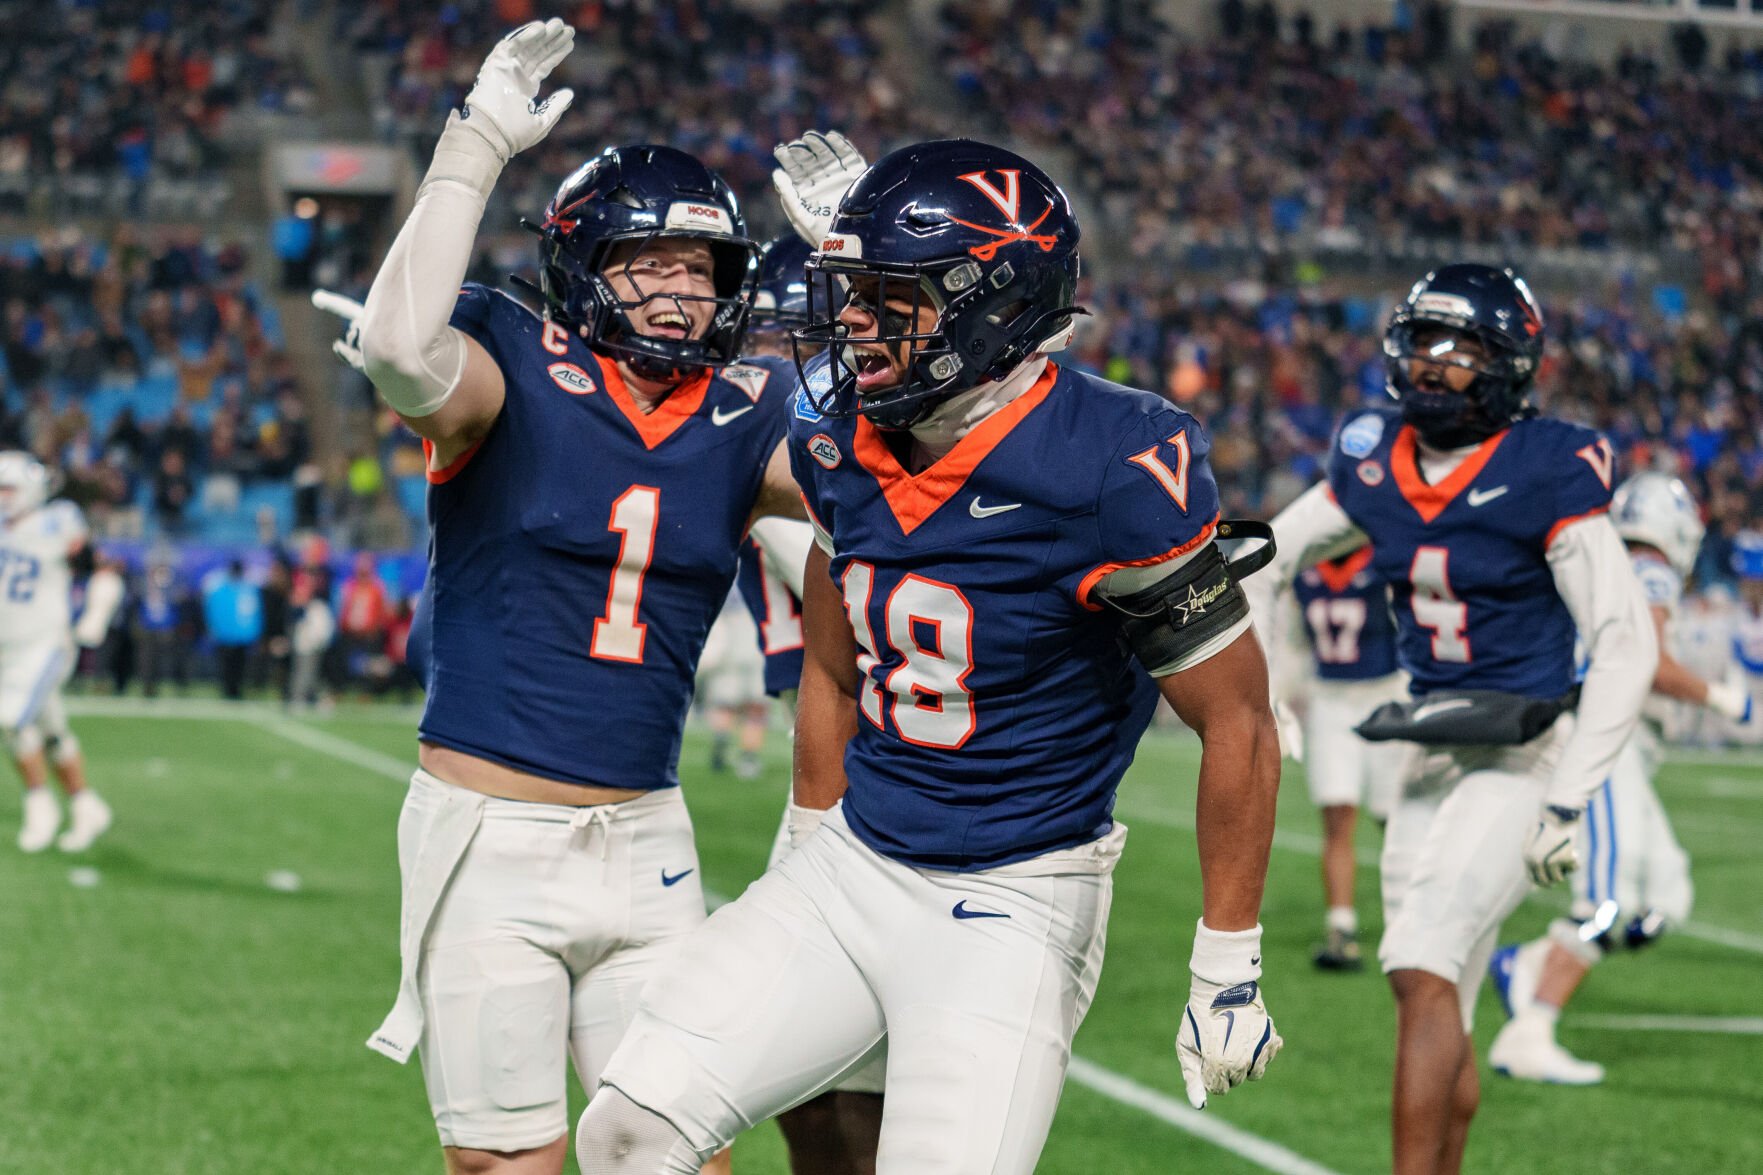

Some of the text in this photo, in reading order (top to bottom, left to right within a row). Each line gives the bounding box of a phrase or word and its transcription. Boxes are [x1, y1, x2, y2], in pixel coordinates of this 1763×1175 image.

[687, 205, 719, 219] HOOS
[956, 169, 1021, 224] V
[541, 319, 569, 357] C
[554, 370, 590, 389] ACC
[814, 442, 836, 459] ACC
[1127, 429, 1192, 513] V
[589, 483, 662, 665] 1
[1189, 581, 1228, 611] Douglas
[1307, 597, 1367, 665] 17
[1409, 545, 1473, 663] 4
[841, 558, 977, 750] 18
